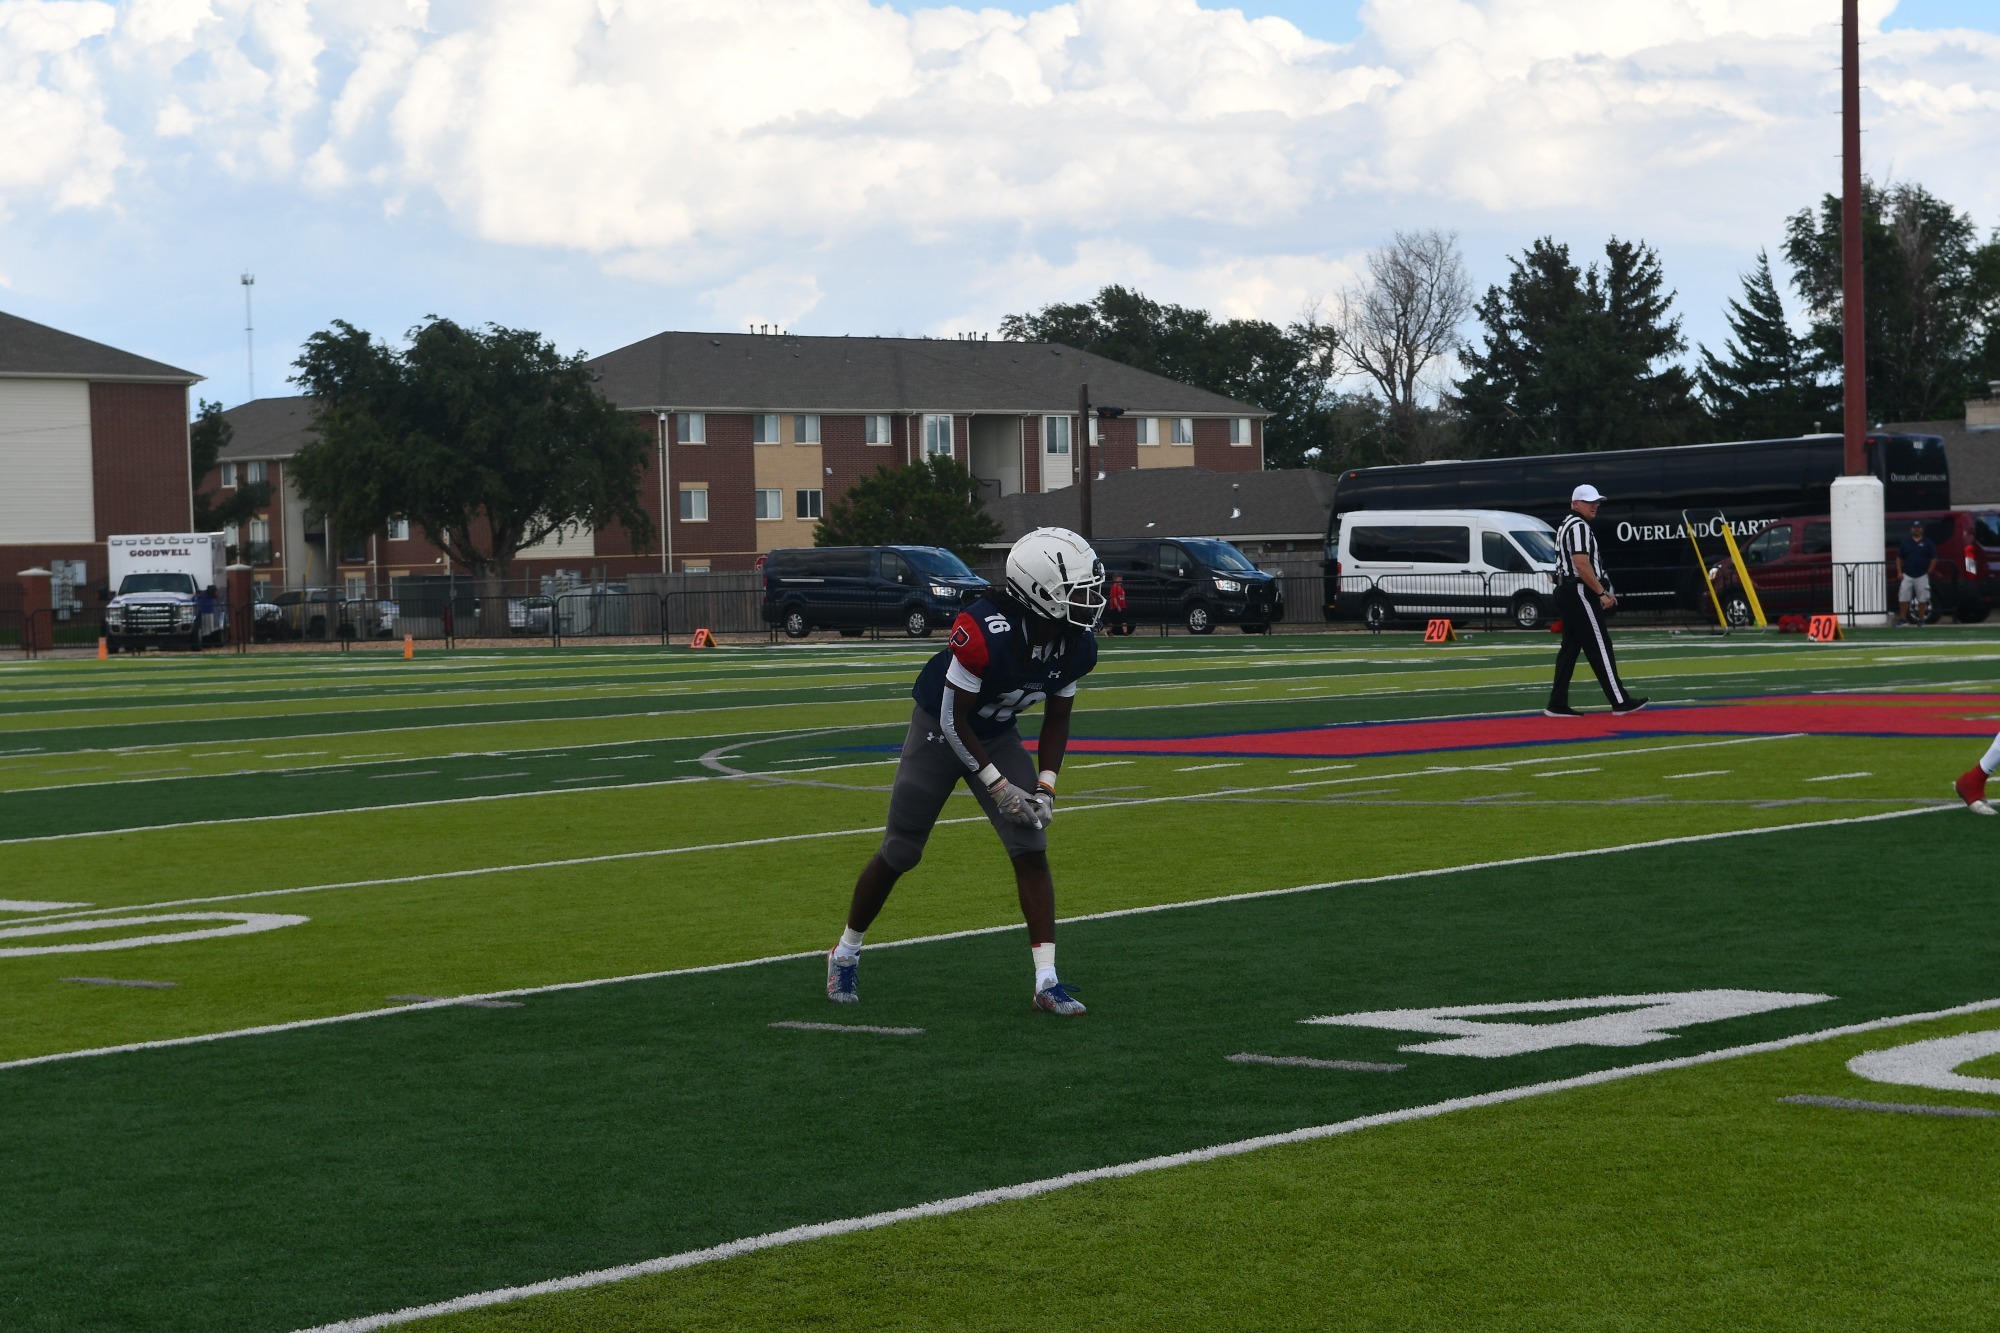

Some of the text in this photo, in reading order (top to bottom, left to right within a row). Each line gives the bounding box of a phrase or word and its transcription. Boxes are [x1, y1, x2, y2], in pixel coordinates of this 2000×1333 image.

[129, 548, 191, 557] GOODWELL
[984, 612, 1012, 634] 16
[1426, 620, 1446, 640] 20
[1811, 617, 1832, 639] 30
[693, 630, 706, 647] G
[949, 625, 970, 647] P
